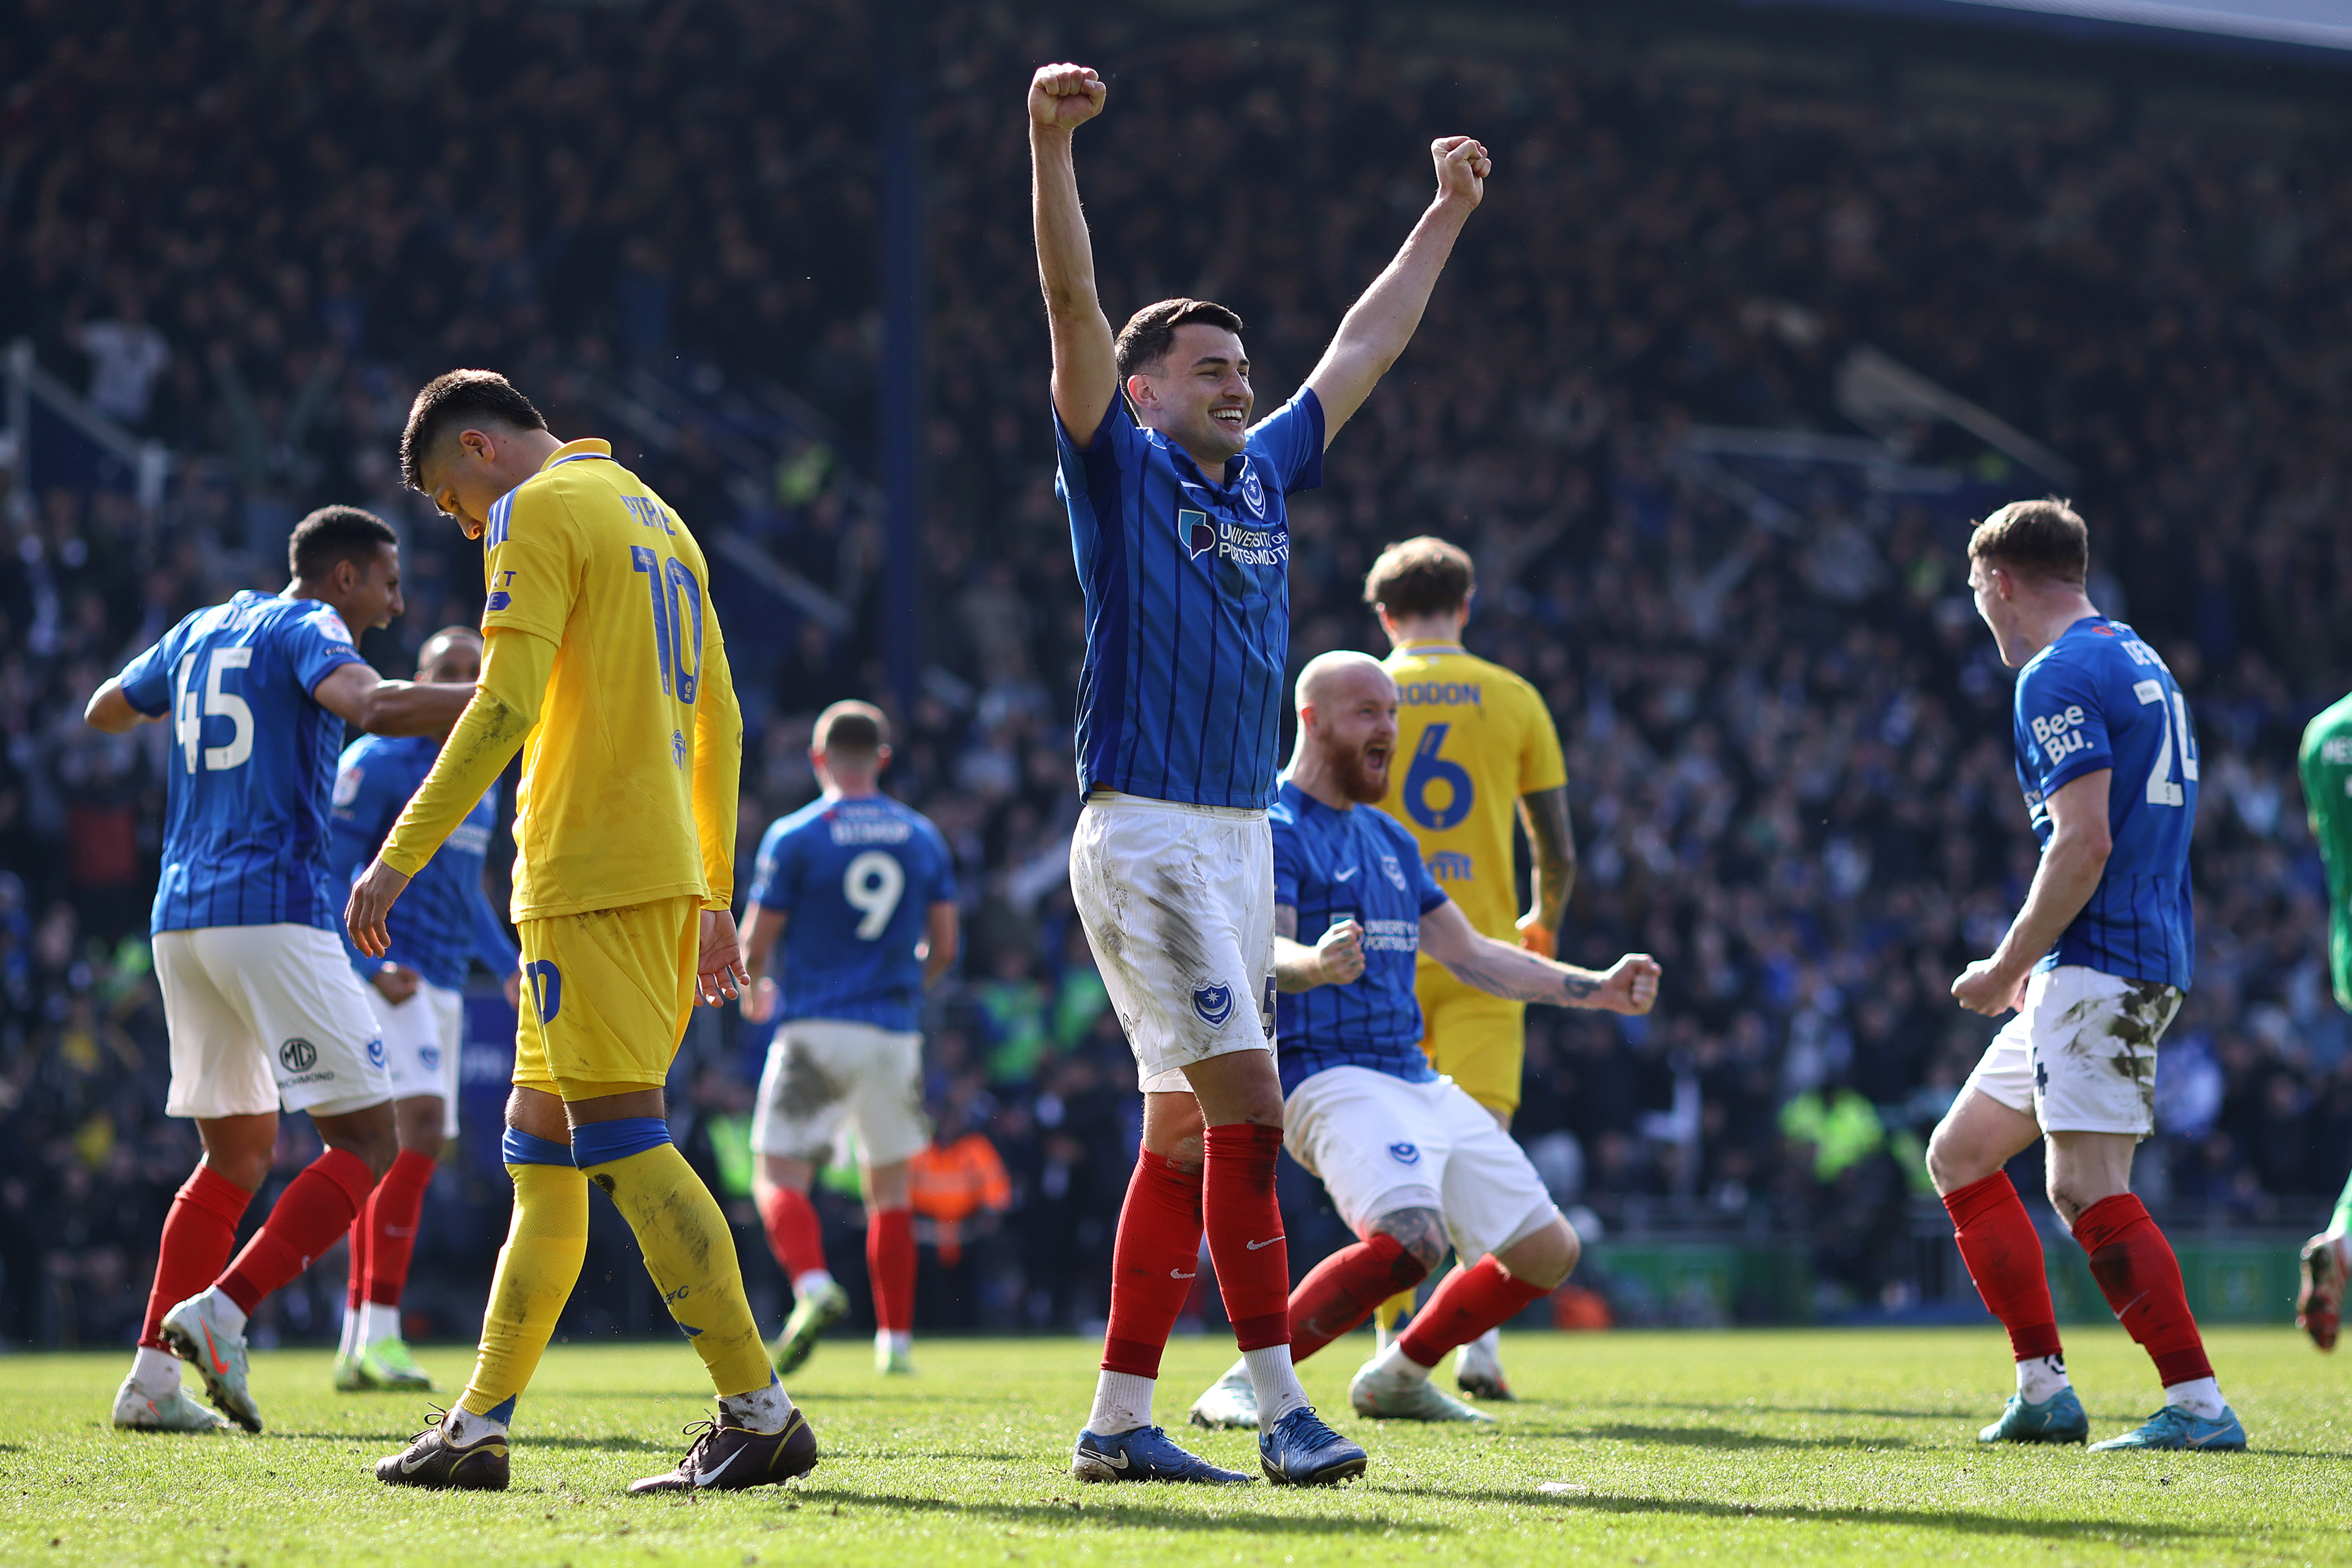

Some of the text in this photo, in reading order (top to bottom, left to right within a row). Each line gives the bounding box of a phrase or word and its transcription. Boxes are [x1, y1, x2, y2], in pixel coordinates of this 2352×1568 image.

[620, 495, 677, 536] PIRE
[1271, 531, 1287, 544] OF
[629, 545, 702, 705] 10
[174, 647, 255, 775] 45
[2031, 704, 2085, 745] Bee
[2044, 729, 2094, 767] Bu.
[1403, 723, 1475, 831] 6
[843, 850, 906, 941] 9
[283, 1042, 313, 1069] MG
